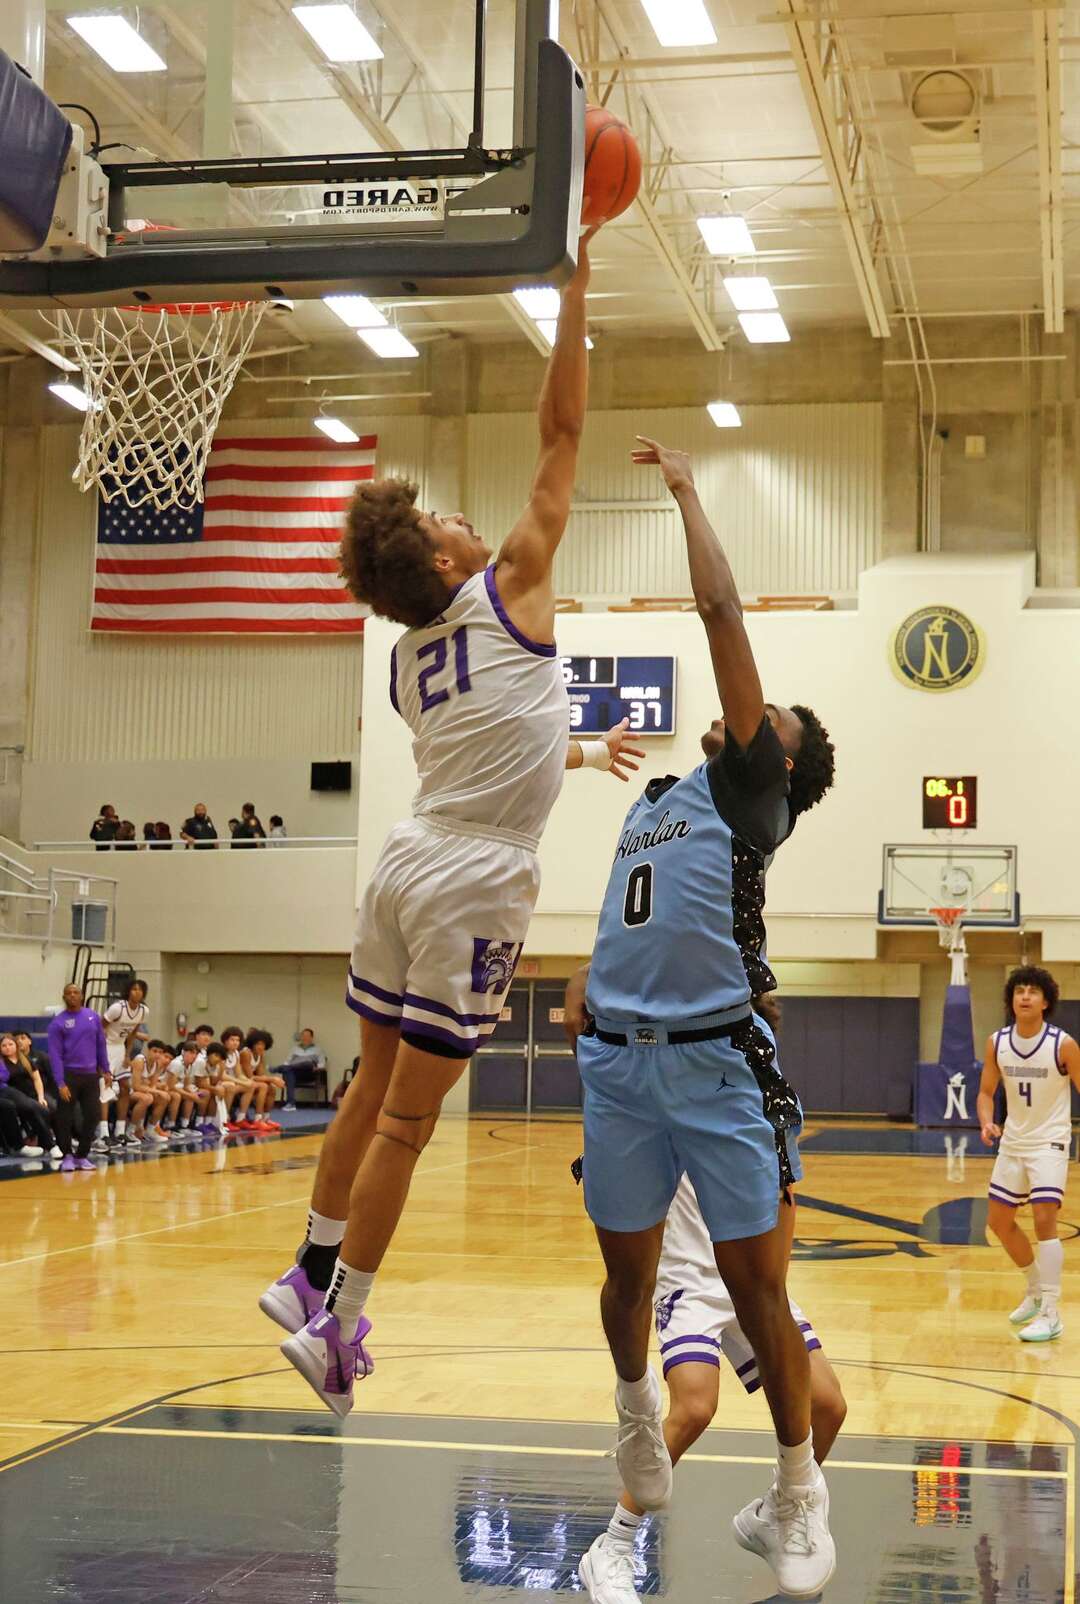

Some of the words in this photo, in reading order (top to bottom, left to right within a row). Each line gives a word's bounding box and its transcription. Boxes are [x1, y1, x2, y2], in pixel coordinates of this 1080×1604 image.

[416, 625, 472, 714] 21
[629, 701, 662, 728] 37
[949, 795, 967, 824] 0
[613, 809, 692, 865] Harlan
[623, 860, 653, 929] 0
[1018, 1082, 1032, 1107] 4
